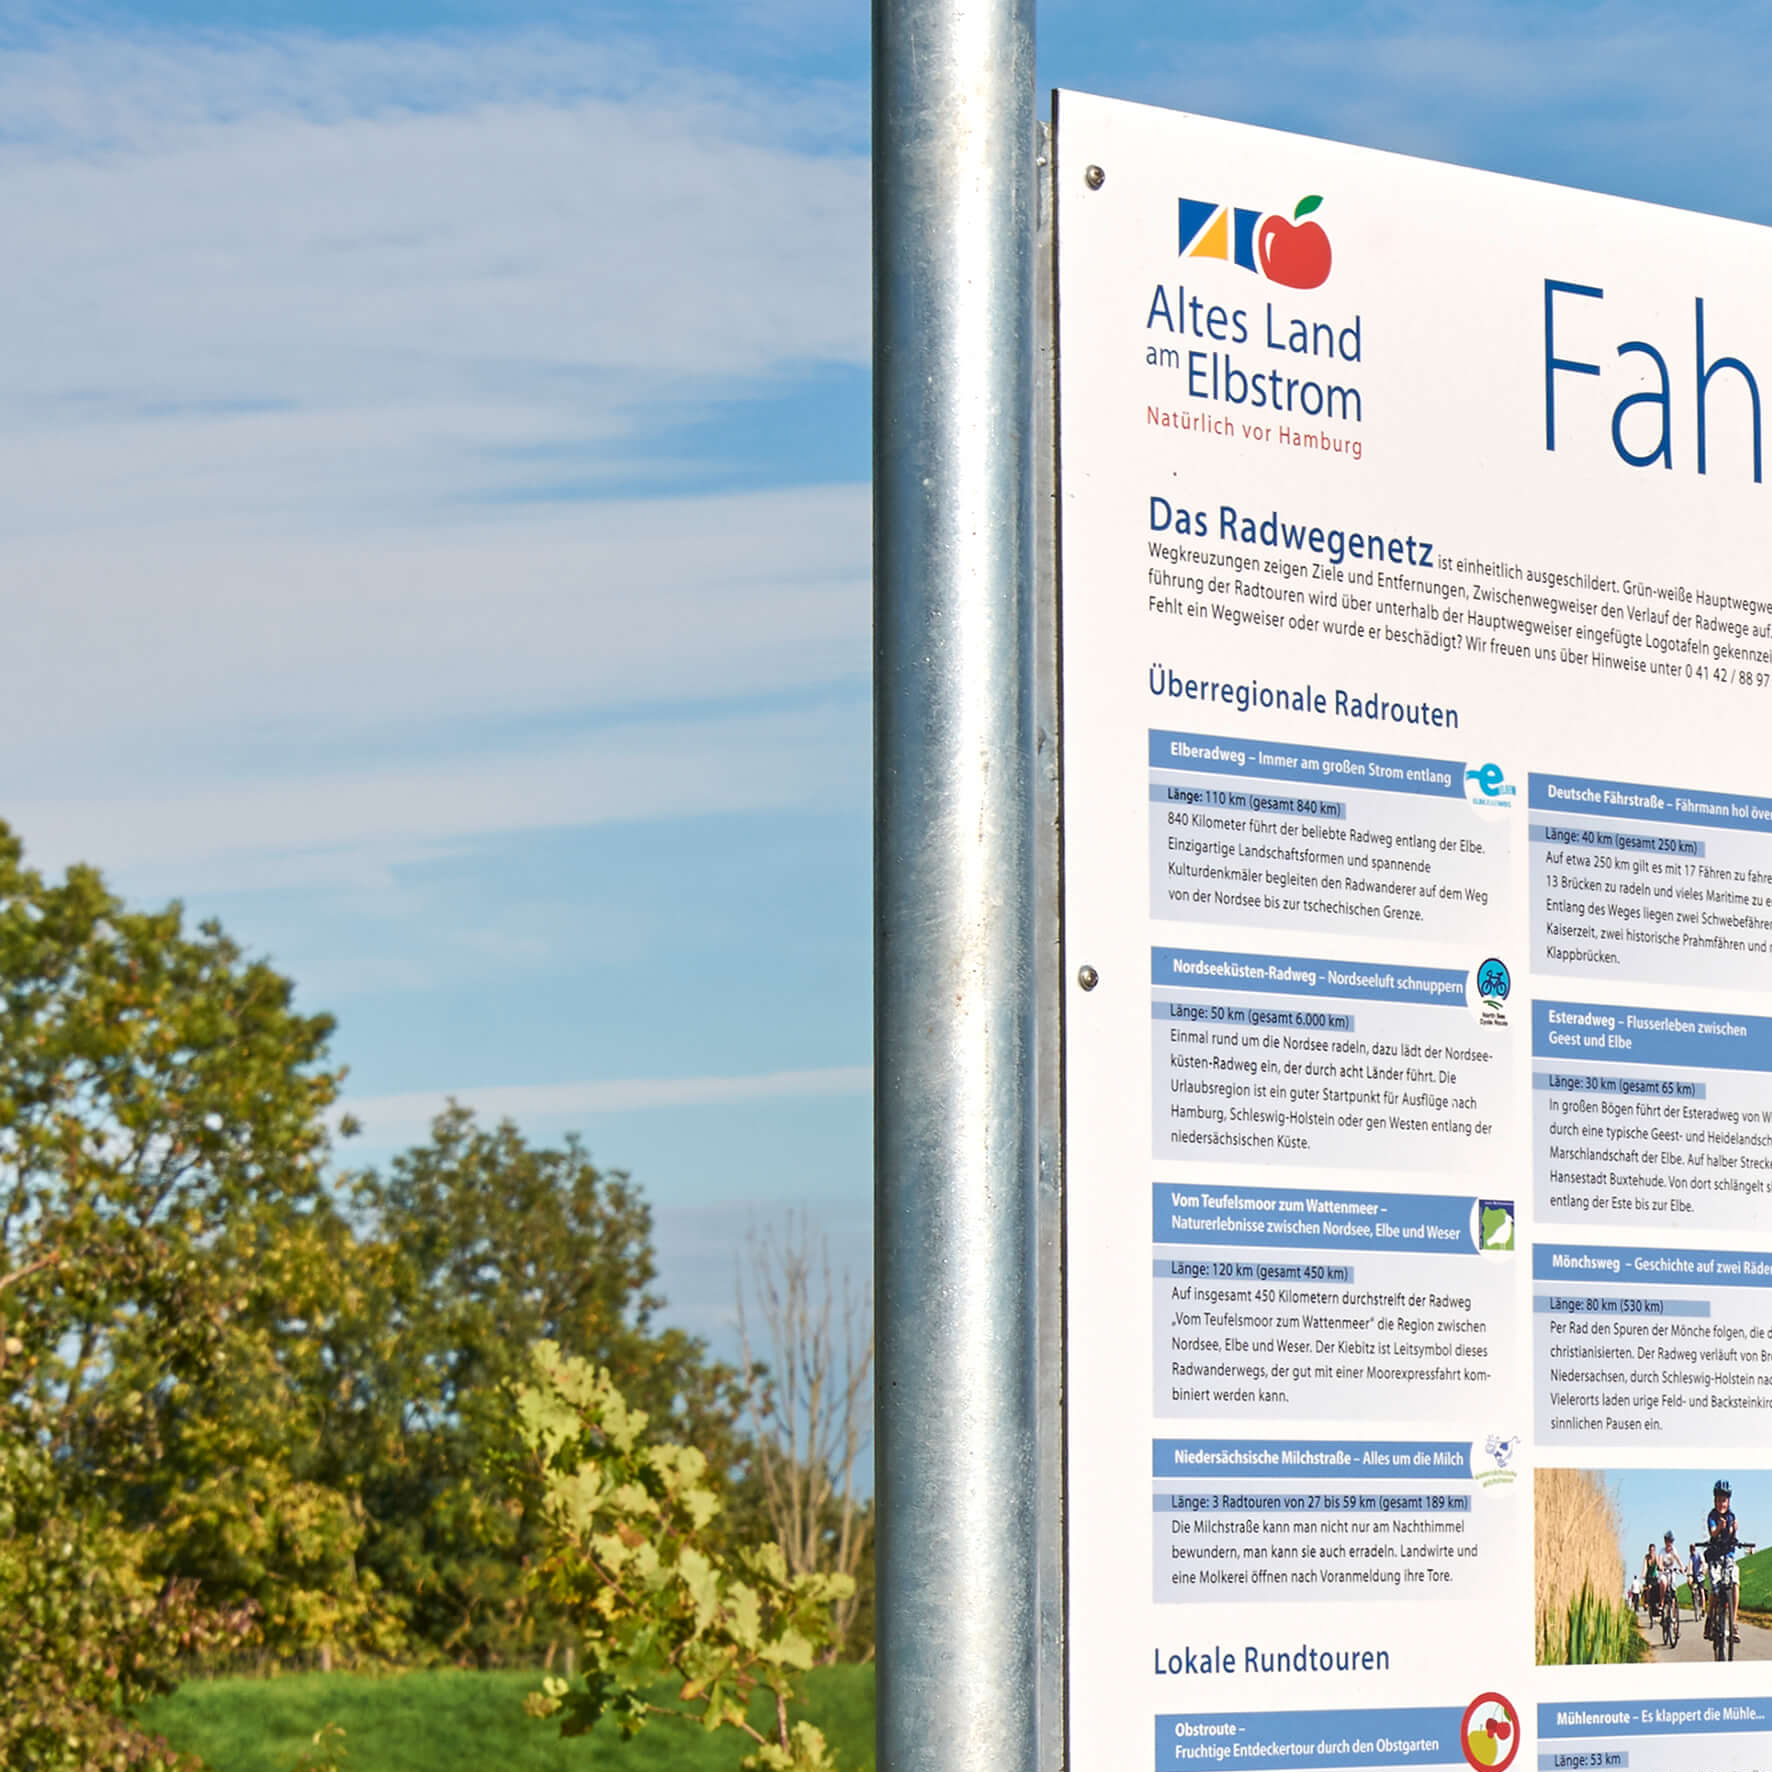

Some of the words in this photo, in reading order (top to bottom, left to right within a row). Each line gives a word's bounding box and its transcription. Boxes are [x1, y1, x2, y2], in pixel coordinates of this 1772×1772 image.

[1146, 284, 1248, 344] Altes
[1266, 302, 1361, 363] Land
[1146, 345, 1179, 369] am
[1188, 350, 1361, 423] Elbstrom
[1147, 405, 1235, 437] Natürlich
[1242, 424, 1272, 442] vor
[1279, 425, 1362, 461] Hamburg
[1150, 496, 1208, 537] Das
[1220, 505, 1433, 568] Radwegenetz
[1438, 558, 1453, 571] ist
[1456, 559, 1523, 580] einheitlich
[1526, 569, 1620, 594] ausgeschildert.
[1623, 579, 1693, 604] Grün-weiße
[1149, 663, 1327, 714] Überregionale
[1335, 689, 1458, 729] Radrouten
[1170, 740, 1246, 767] Elberadweg
[1258, 750, 1298, 769] Immer
[1300, 758, 1320, 771] am
[1322, 759, 1366, 776] großen
[1367, 762, 1404, 780] Strom
[1406, 768, 1451, 788] entlang
[1167, 786, 1203, 805] Länge:
[1205, 790, 1227, 805] 110
[1228, 791, 1247, 807] km
[1248, 793, 1295, 812] (gesamt
[1296, 799, 1318, 815] 840
[1319, 800, 1341, 818] km)
[1548, 783, 1602, 803] Deutsche
[1603, 789, 1665, 809] Fährstraße
[1675, 798, 1730, 817] Fährmann
[1731, 803, 1749, 819] hol
[1172, 958, 1317, 987] Nordseeküsten-Radweg
[1327, 970, 1395, 989] Nordseeluft
[1396, 976, 1464, 996] schnuppern
[1548, 1009, 1616, 1031] Esteradweg
[1626, 1015, 1696, 1033] Flusserleben
[1697, 1021, 1747, 1037] zwischen
[1548, 1030, 1582, 1047] Geest
[1583, 1033, 1606, 1048] und
[1608, 1034, 1632, 1049] Elbe
[1552, 1254, 1621, 1273] Mönchsweg
[1634, 1257, 1695, 1273] Geschichte
[1696, 1258, 1715, 1273] auf
[1716, 1261, 1742, 1274] zwei
[1174, 1449, 1279, 1464] Niedersächsische
[1281, 1449, 1352, 1465] Milchstraße
[1362, 1451, 1390, 1466] Alles
[1392, 1454, 1411, 1466] um
[1412, 1451, 1432, 1466] die
[1433, 1451, 1464, 1466] Milch
[1154, 1645, 1235, 1675] Lokale
[1245, 1644, 1389, 1673] Rundtouren
[1175, 1722, 1237, 1737] Obstroute
[1175, 1743, 1231, 1761] Fruchtige
[1232, 1741, 1315, 1757] Entdeckertour
[1316, 1739, 1350, 1755] durch
[1351, 1738, 1374, 1754] den
[1375, 1737, 1440, 1755] Obstgarten
